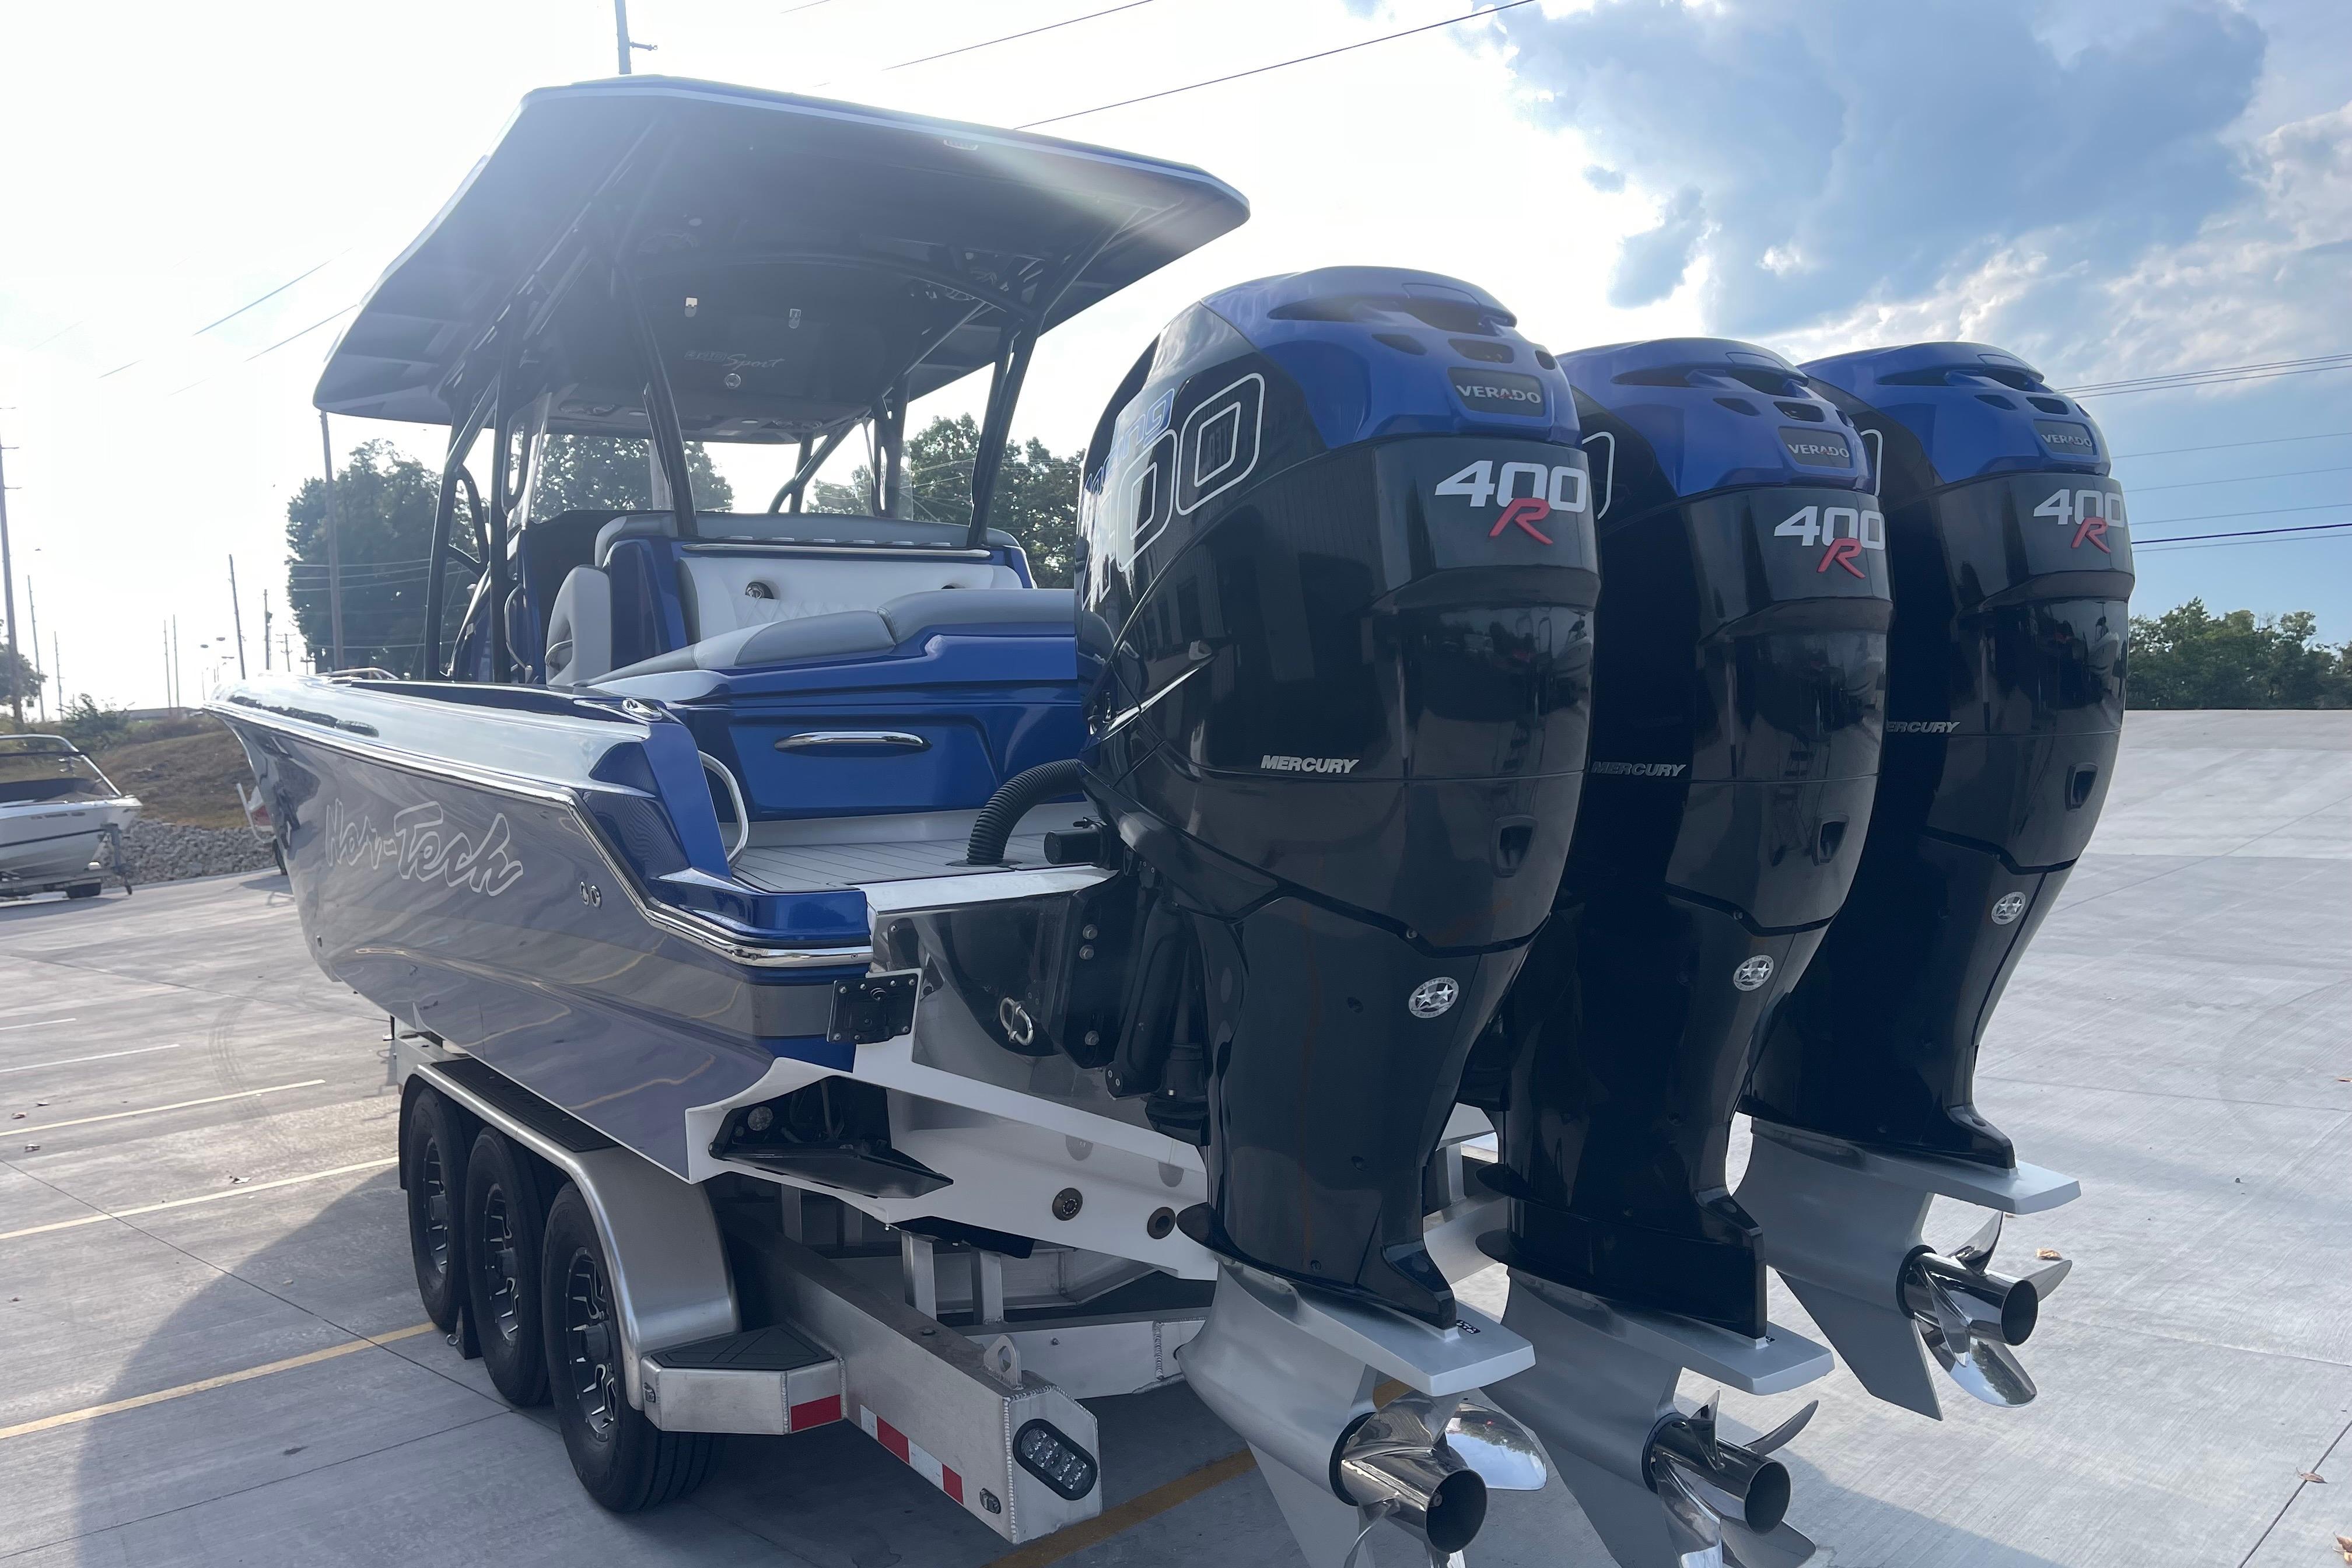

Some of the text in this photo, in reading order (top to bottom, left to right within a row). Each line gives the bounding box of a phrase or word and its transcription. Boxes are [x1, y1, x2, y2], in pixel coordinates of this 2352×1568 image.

[722, 354, 786, 371] Sport
[1455, 384, 1542, 405] VERADO
[1787, 443, 1850, 459] VERADO
[2042, 433, 2093, 449] VERADO
[1435, 460, 1587, 513] 400
[1489, 498, 1553, 545] R
[2032, 489, 2124, 528] 400
[1773, 506, 1885, 550] 400
[2070, 516, 2111, 554] R
[1817, 537, 1867, 579] R
[1886, 721, 1961, 733] ERCURY
[1261, 755, 1360, 774] MERCURY
[1591, 761, 1687, 777] MERCURY
[324, 797, 524, 897] Nor-Tech
